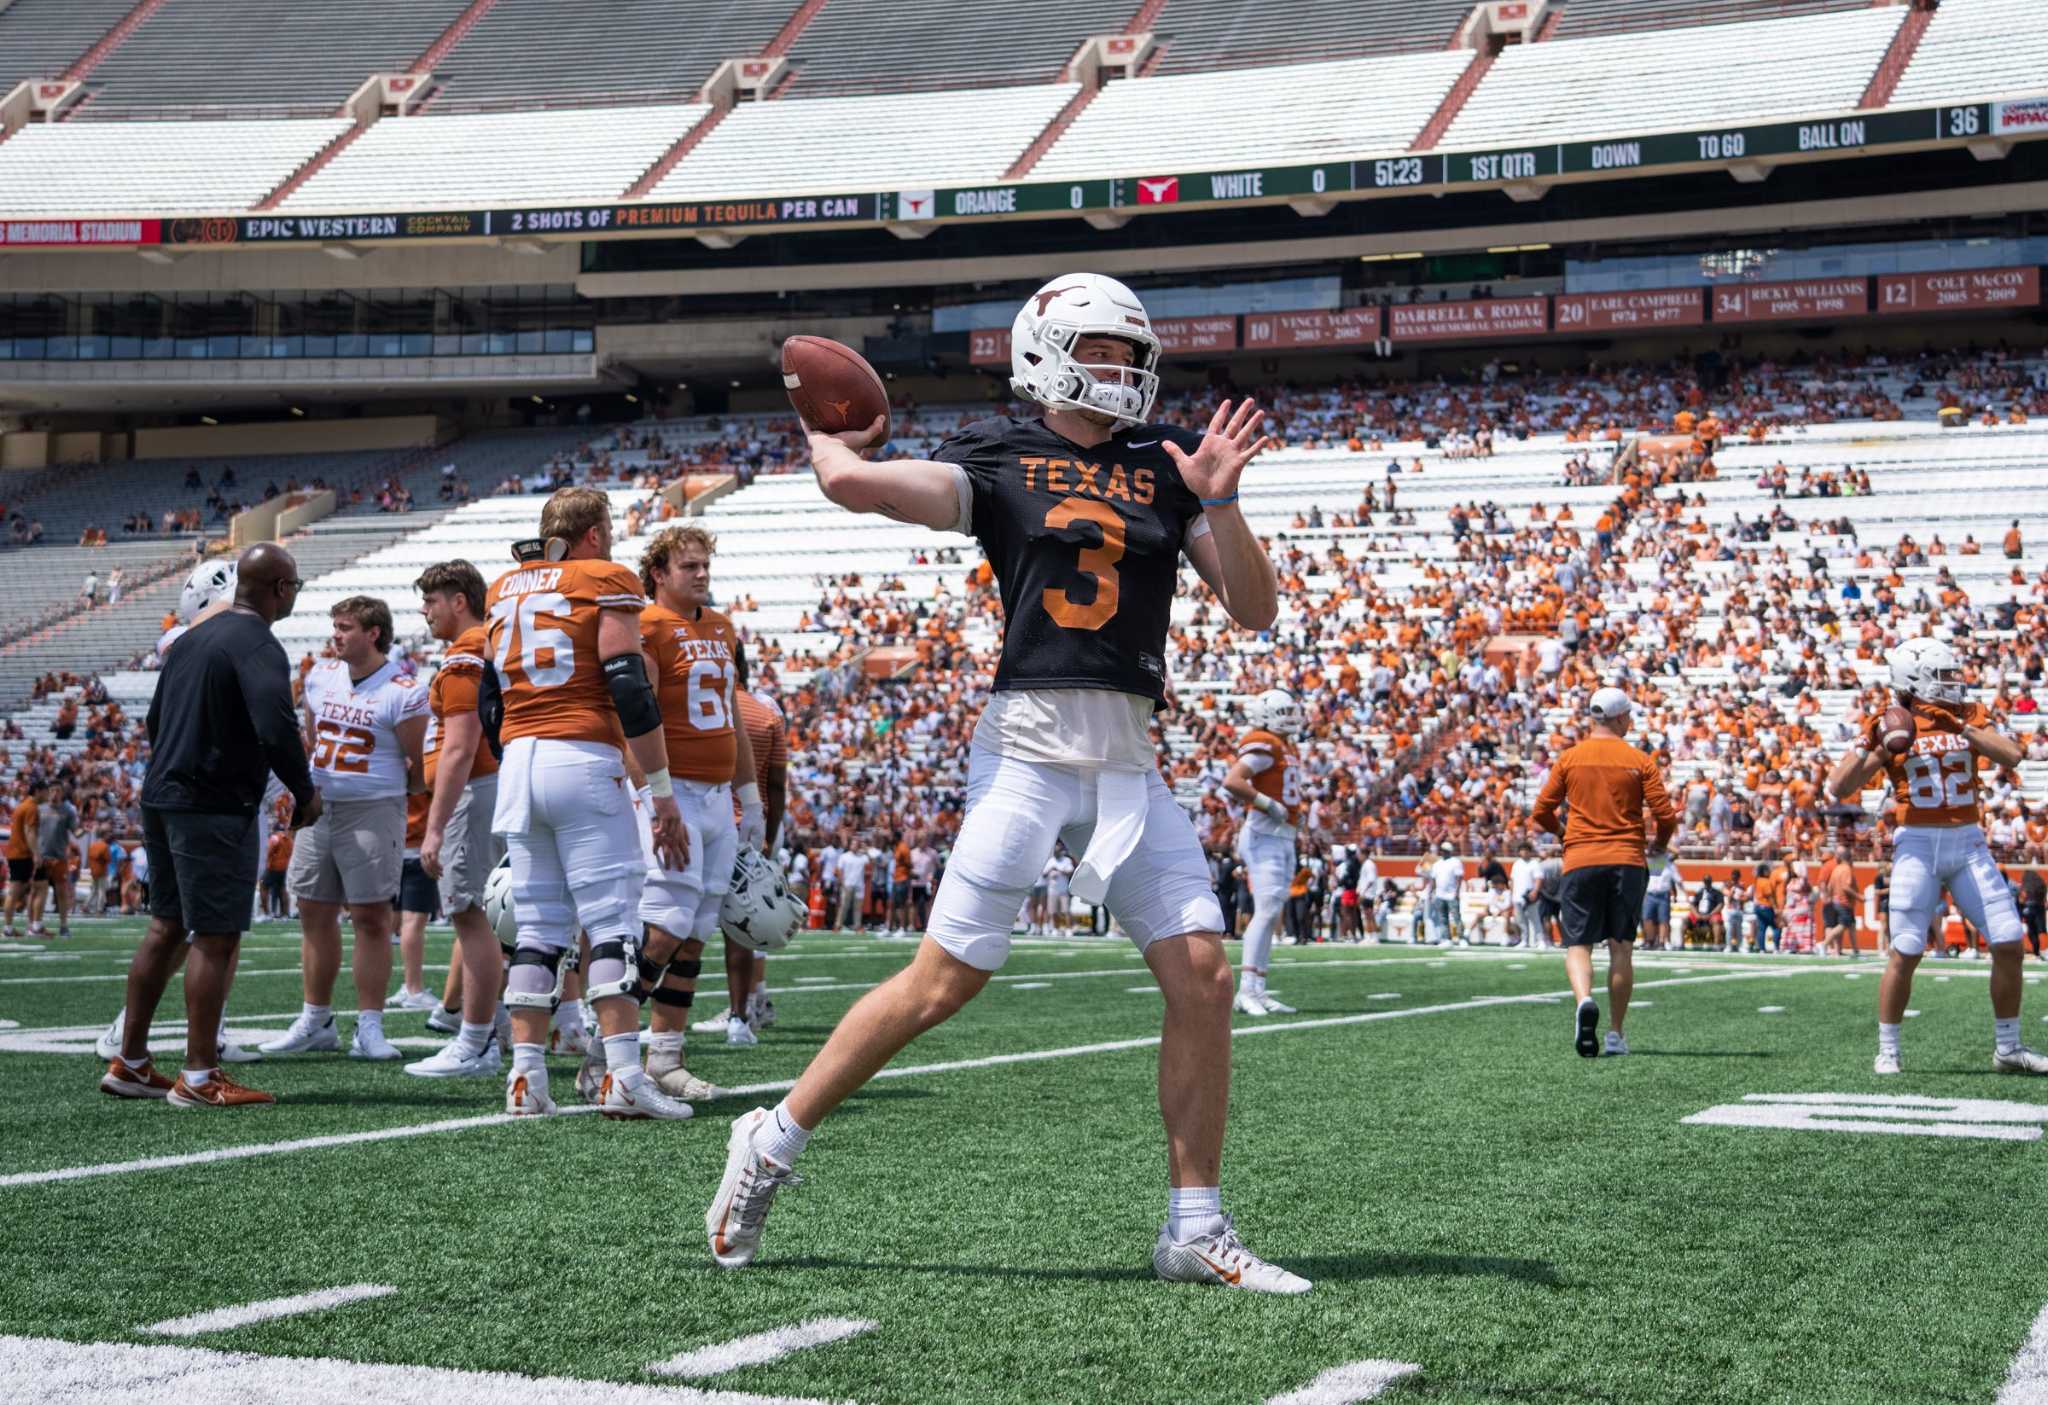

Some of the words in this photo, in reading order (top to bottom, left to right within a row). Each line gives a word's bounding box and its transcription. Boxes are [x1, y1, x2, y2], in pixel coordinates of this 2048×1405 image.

[1950, 106, 1979, 136] 36
[1799, 124, 1838, 149] BALL
[1840, 121, 1865, 145] ON
[1592, 142, 1641, 168] DOWN
[1698, 135, 1719, 160] TO
[1721, 133, 1745, 157] GO
[1375, 158, 1423, 186] 51:23
[1470, 154, 1499, 180] 1ST
[1501, 152, 1536, 179] QTR
[1211, 173, 1263, 199] WHITE
[1312, 169, 1325, 193] 0
[955, 188, 1016, 215] ORANGE
[1070, 186, 1083, 209] 0
[406, 214, 471, 225] COCKTAIL
[511, 213, 523, 230] 2
[528, 211, 583, 229] SHOTS
[588, 210, 611, 227] OF
[616, 207, 698, 225] PREMIUM
[704, 202, 777, 221] TEQUILA
[782, 199, 817, 219] PER
[822, 198, 859, 217] CAN
[7, 221, 77, 242] MEMORIAL
[80, 220, 142, 242] STADIUM
[247, 219, 295, 238] EPIC
[300, 216, 398, 238] WESTERN
[406, 223, 471, 234] COMPANY
[1751, 287, 1792, 300] RICKY
[1794, 282, 1864, 298] WILLIAMS
[1885, 283, 1907, 304] 12
[1926, 276, 1968, 290] COLT
[1591, 297, 1627, 311] EARL
[1628, 292, 1698, 309] CAMPBELL
[1717, 292, 1742, 313] 34
[1280, 315, 1322, 329] VINCE
[1327, 311, 1375, 326] YOUNG
[1394, 305, 1468, 324] DARRELL
[1491, 302, 1543, 319] ROYAL
[1559, 303, 1584, 323] 20
[1250, 321, 1270, 341] 10
[1394, 324, 1427, 336] TEXAS
[1431, 321, 1489, 333] MEMORIAL
[1493, 317, 1543, 331] STADIUM
[975, 337, 994, 355] 22
[1019, 456, 1155, 505] TEXAS
[1042, 496, 1126, 631] 3
[498, 567, 563, 598] CONNER
[490, 591, 575, 693] 76
[679, 639, 732, 660] TEXAS
[322, 702, 374, 727] TEXAS
[1904, 751, 1975, 808] 82
